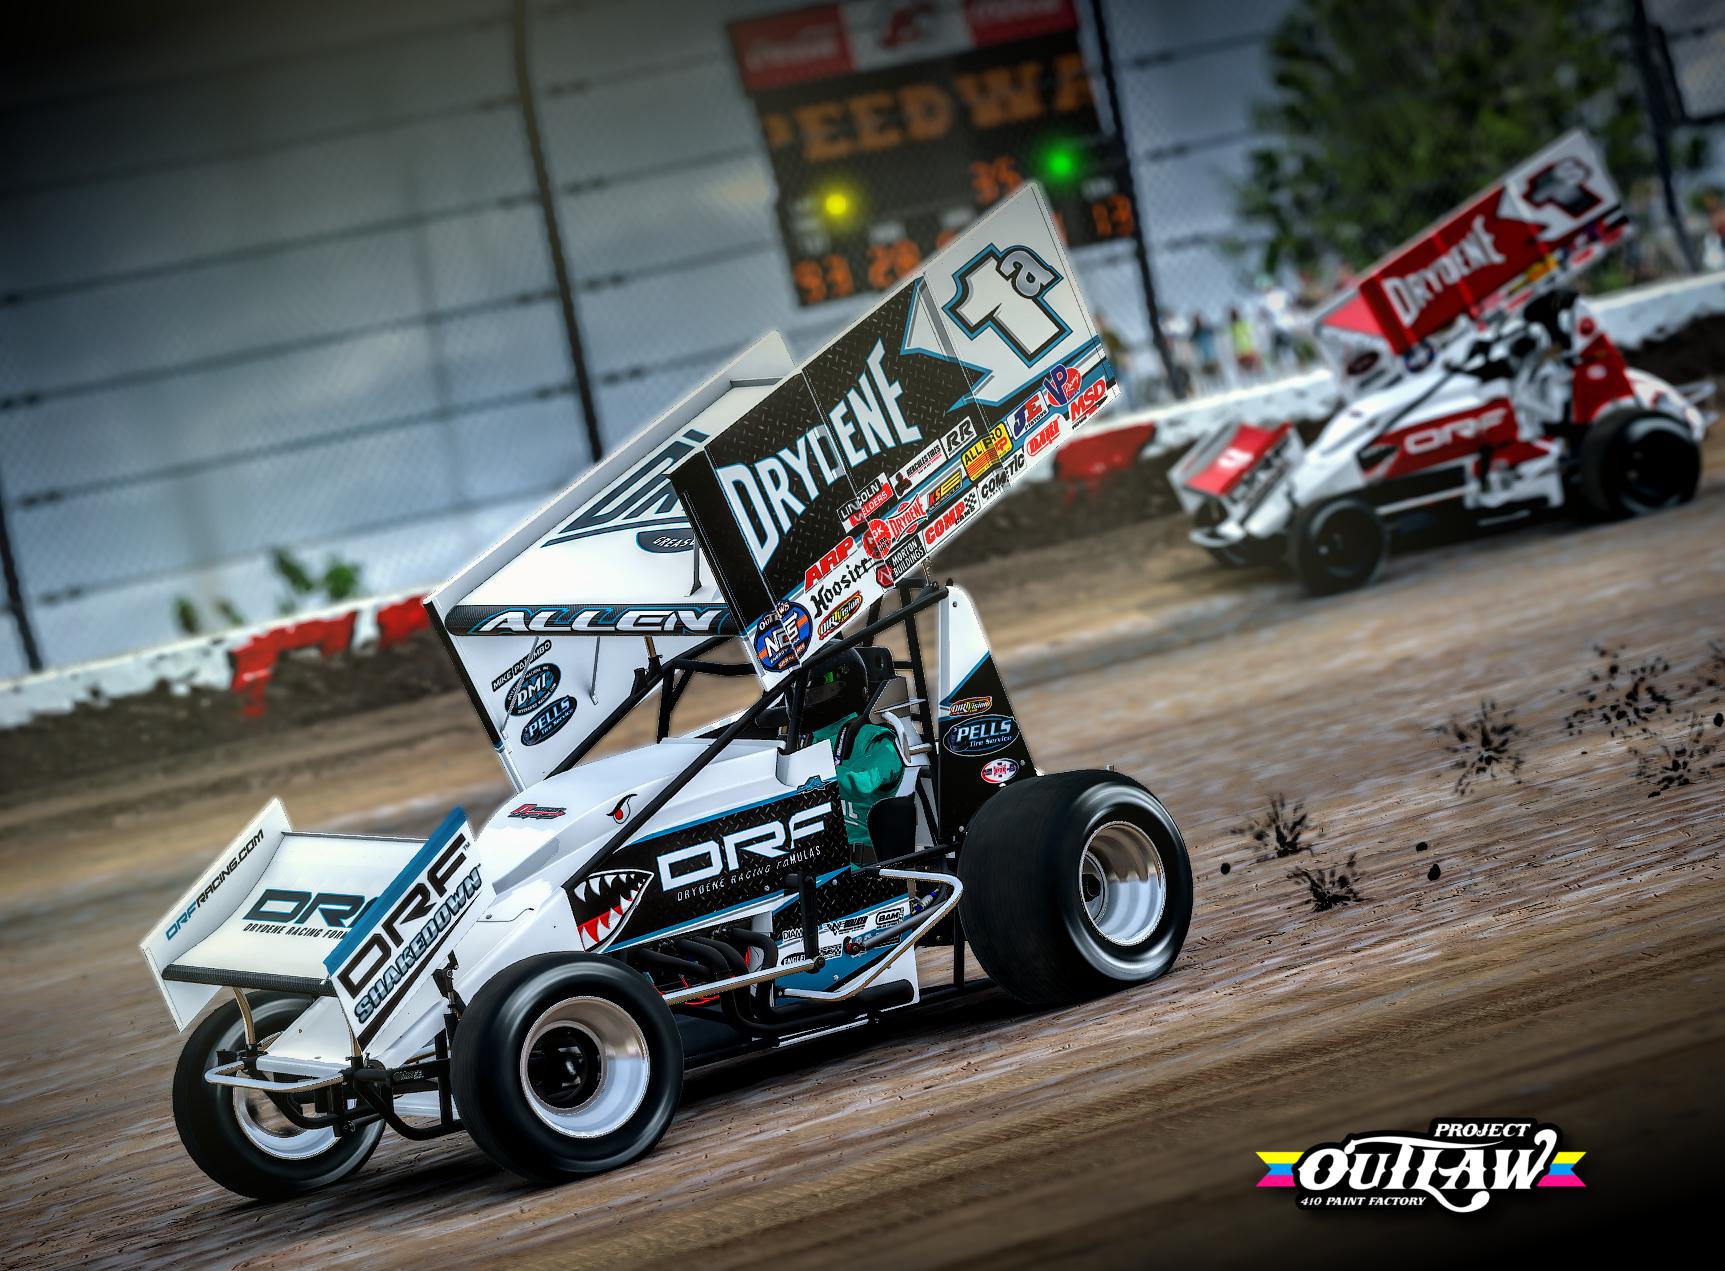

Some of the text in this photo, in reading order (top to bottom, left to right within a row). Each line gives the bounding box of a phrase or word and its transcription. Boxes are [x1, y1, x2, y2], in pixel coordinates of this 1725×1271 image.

[1013, 394, 1042, 437] JE
[1070, 378, 1106, 423] MSD
[716, 338, 922, 573] DRYDENE
[946, 419, 974, 452] RR
[963, 445, 983, 466] ALL
[888, 495, 926, 539] DRYDENE
[924, 500, 966, 546] COMP
[804, 535, 855, 591] ARP
[892, 539, 918, 566] MORTON
[893, 547, 924, 578] BUILDINGS
[477, 609, 723, 632] ALLEN
[492, 668, 513, 690] MIKE
[514, 640, 551, 674] PAMBO
[517, 673, 547, 707] DMI
[527, 694, 571, 738] PELLS
[956, 719, 1012, 742] PELLS
[969, 735, 1012, 748] Tire Service
[656, 801, 834, 893] DRF
[164, 828, 265, 942] DRFRACING.COM
[676, 877, 726, 902] DRYDENE
[729, 864, 772, 885] RACING
[242, 888, 380, 929] DR
[336, 832, 467, 1000] DRF
[243, 922, 287, 935] DRYDENE
[285, 926, 322, 939] RACING
[353, 866, 483, 1024] SHAKEDOWN
